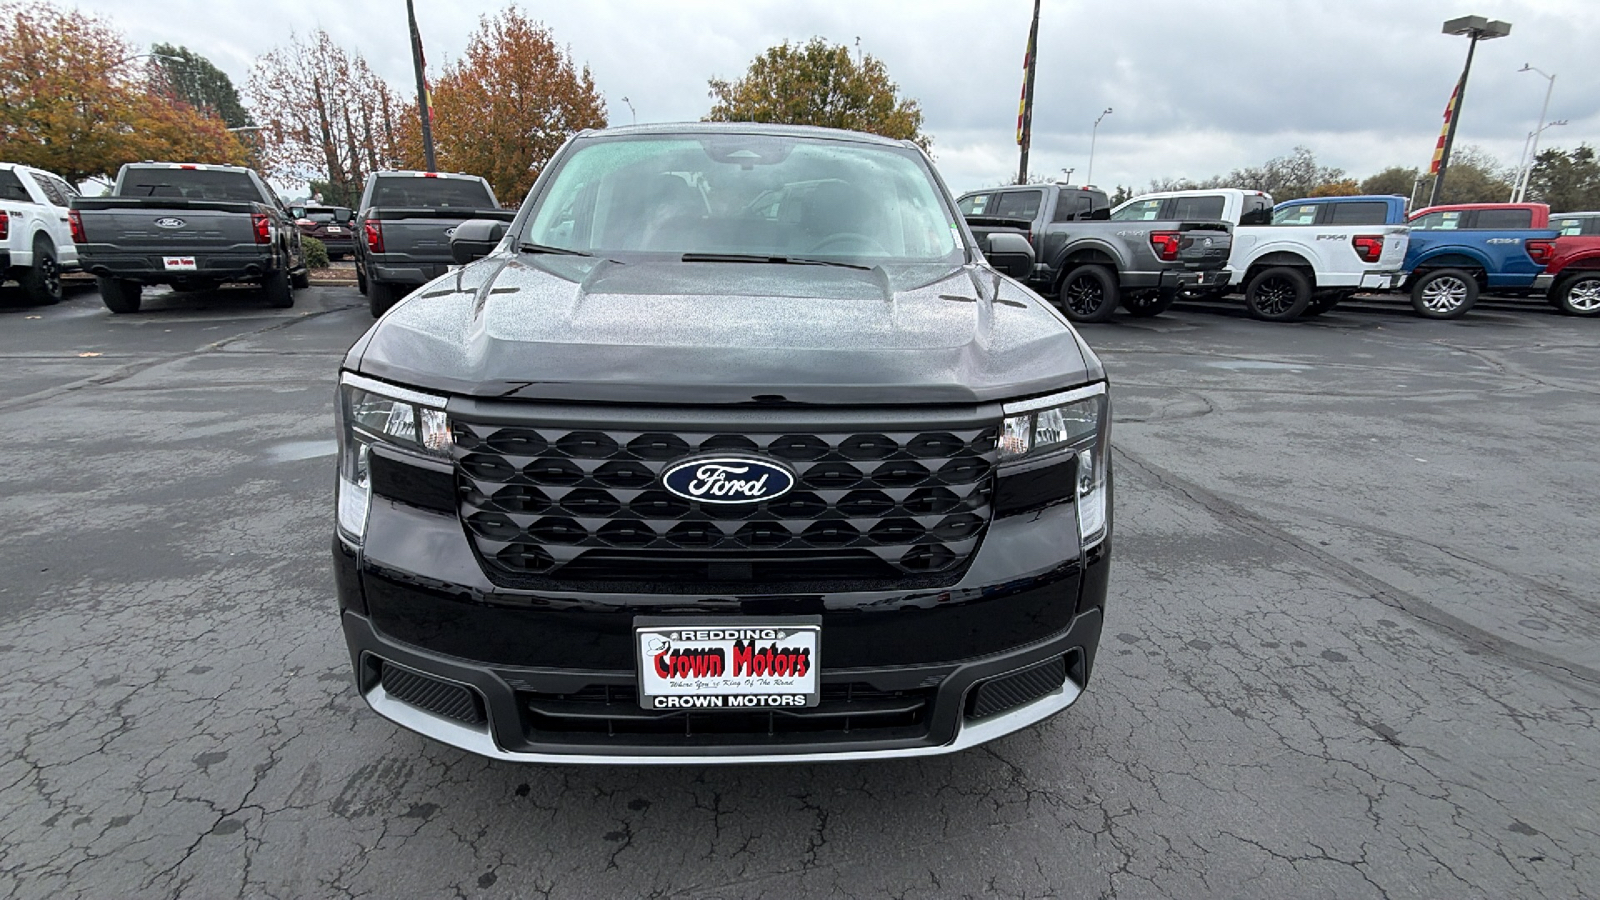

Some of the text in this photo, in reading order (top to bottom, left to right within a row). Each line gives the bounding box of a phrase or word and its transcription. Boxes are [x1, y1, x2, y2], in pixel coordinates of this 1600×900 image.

[688, 464, 769, 496] Ford
[681, 629, 776, 641] REDDING
[653, 640, 811, 679] Crown Motors
[723, 679, 741, 688] King
[744, 679, 755, 688] Of
[757, 678, 771, 686] The
[654, 694, 806, 709] CROWN MOTORS
